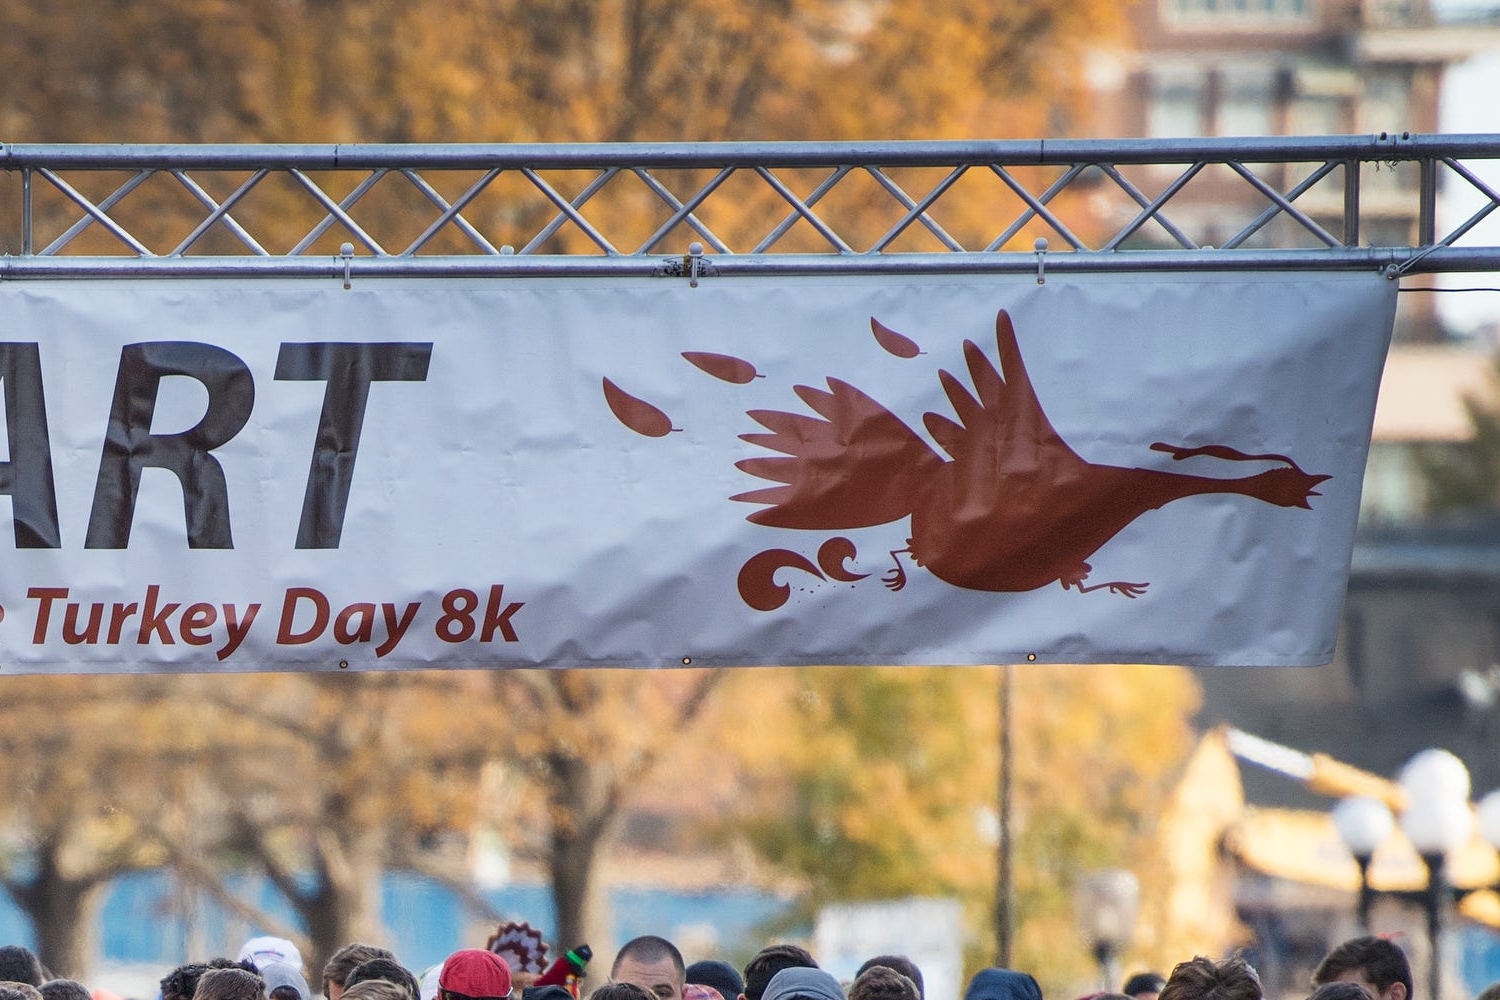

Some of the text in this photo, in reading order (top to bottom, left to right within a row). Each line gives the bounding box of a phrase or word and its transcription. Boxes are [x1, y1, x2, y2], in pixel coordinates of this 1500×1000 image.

[27, 586, 261, 661] Turkey
[277, 587, 421, 659] Day
[435, 584, 526, 645] 8k
